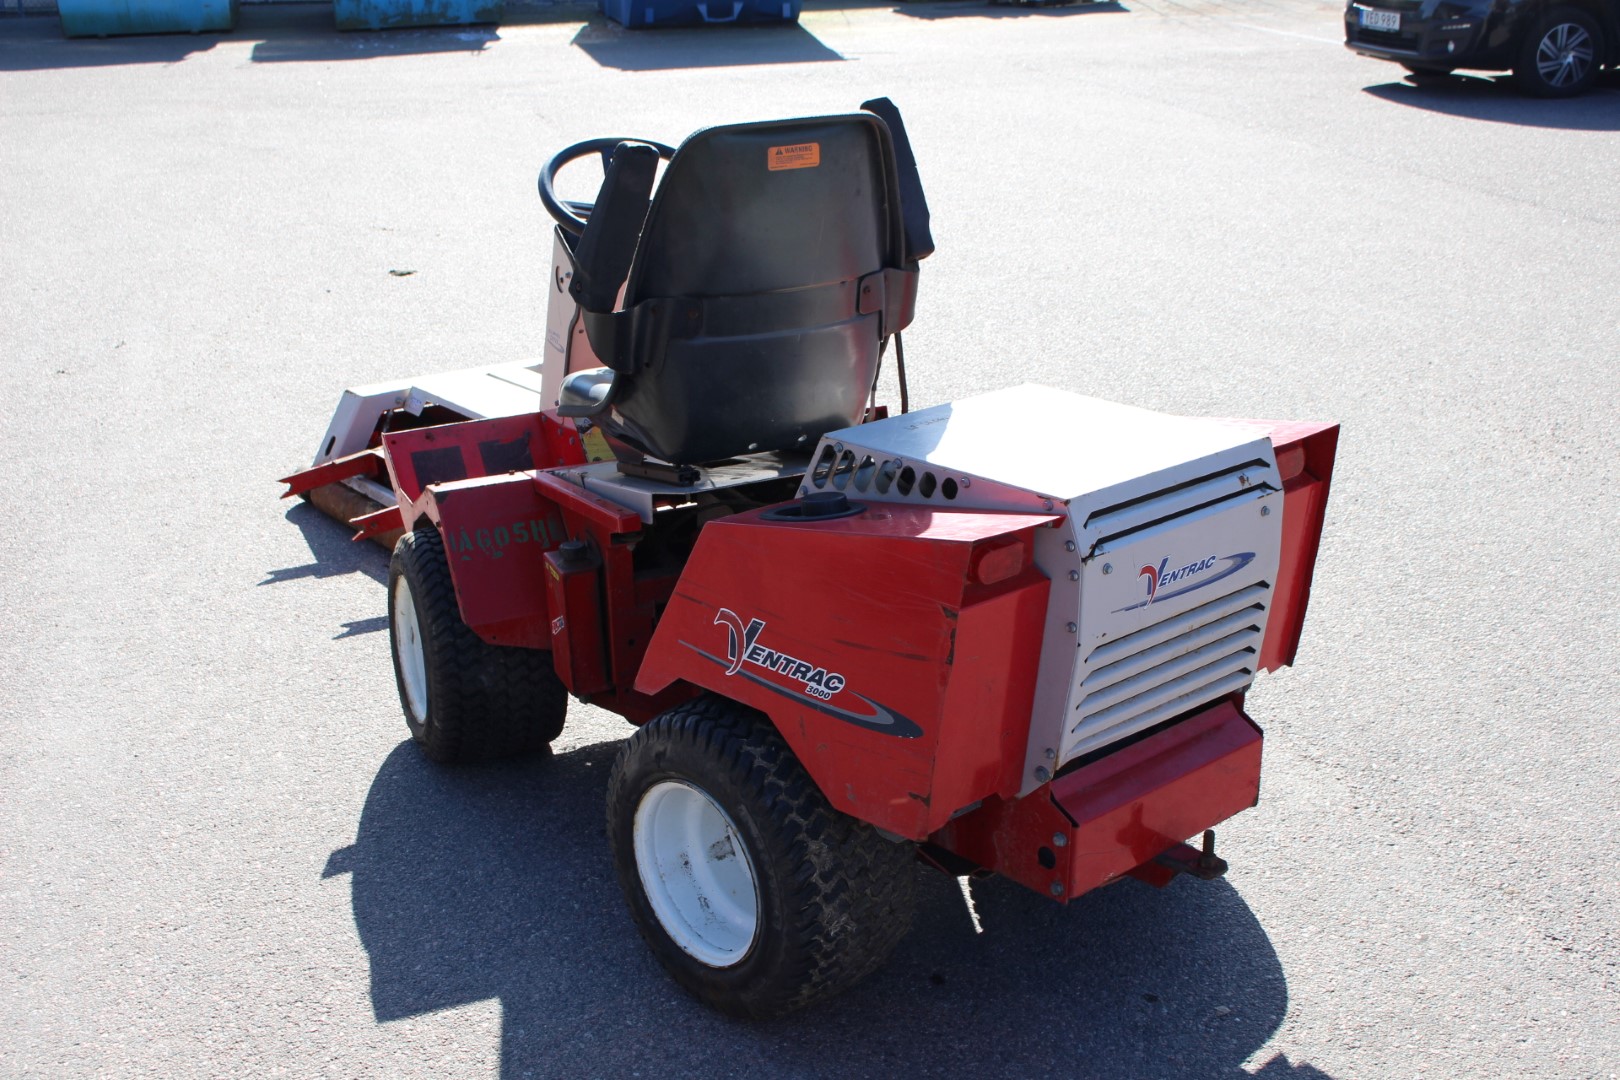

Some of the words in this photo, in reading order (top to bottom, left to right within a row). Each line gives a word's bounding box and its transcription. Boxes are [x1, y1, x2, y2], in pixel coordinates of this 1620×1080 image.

[784, 145, 812, 154] WARNING
[1137, 553, 1217, 611] VENTRAC
[714, 608, 846, 692] VENTRAC
[805, 684, 832, 701] 3000
